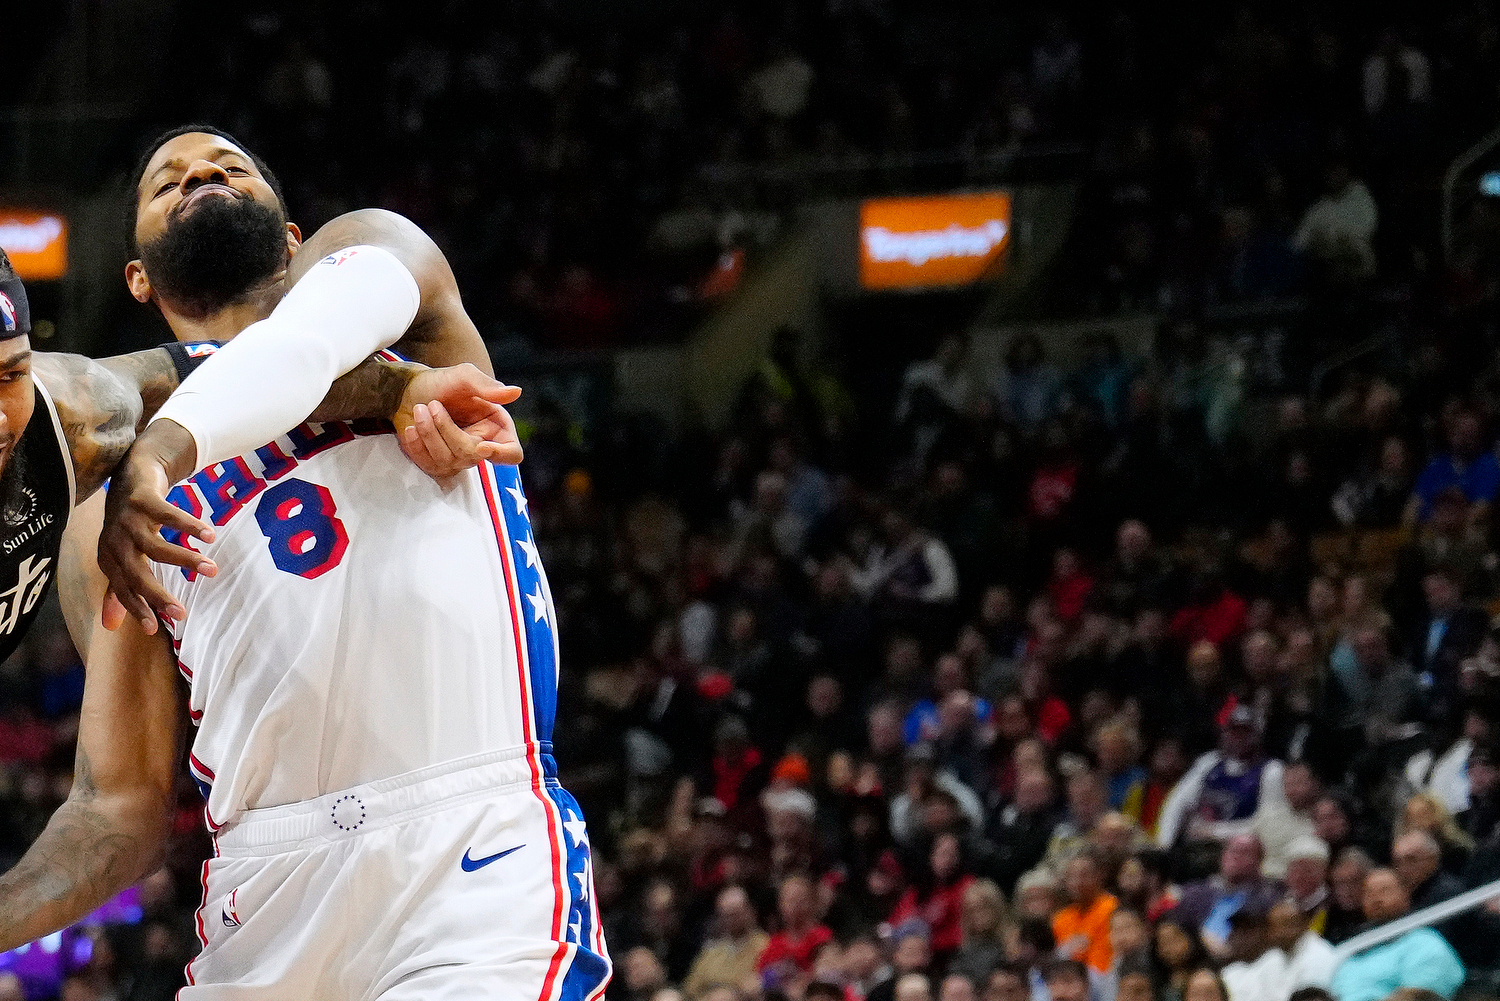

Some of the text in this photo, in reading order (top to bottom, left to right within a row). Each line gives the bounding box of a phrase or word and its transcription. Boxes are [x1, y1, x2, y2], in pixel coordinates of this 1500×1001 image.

[2, 513, 54, 554] Sun Life
[253, 476, 351, 580] 8
